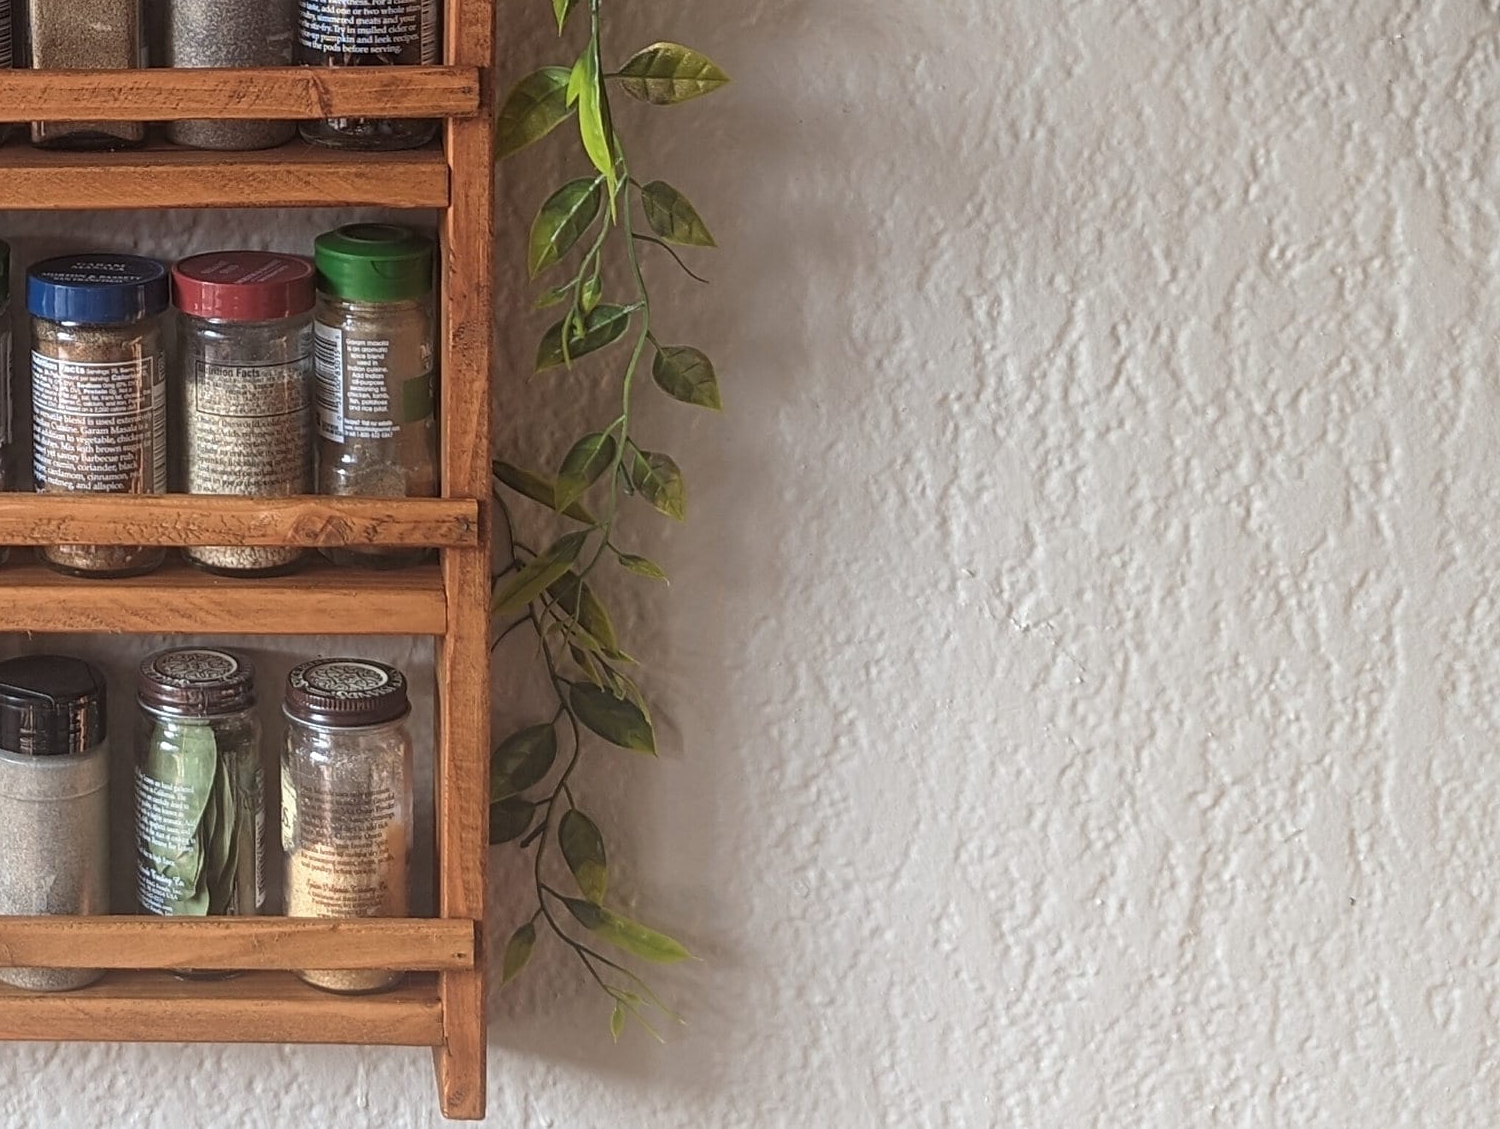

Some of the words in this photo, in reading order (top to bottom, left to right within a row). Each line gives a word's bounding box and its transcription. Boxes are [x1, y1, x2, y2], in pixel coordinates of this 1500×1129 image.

[363, 6, 380, 16] two
[381, 5, 405, 15] whole
[382, 15, 400, 24] and
[400, 14, 417, 27] your
[357, 24, 387, 34] mulled
[356, 34, 373, 44] and
[374, 33, 392, 44] leek
[323, 42, 342, 53] pods
[342, 43, 369, 53] before
[370, 44, 402, 55] serving.
[236, 368, 260, 378] Facts
[64, 413, 86, 425] blend
[87, 415, 95, 425] is
[95, 414, 116, 426] used
[81, 426, 109, 435] Garam
[76, 436, 116, 446] vegetable,
[96, 445, 122, 454] brown
[77, 463, 118, 473] coriander,
[87, 472, 129, 482] cinnamon,
[76, 481, 92, 490] and
[93, 481, 126, 492] allspice.
